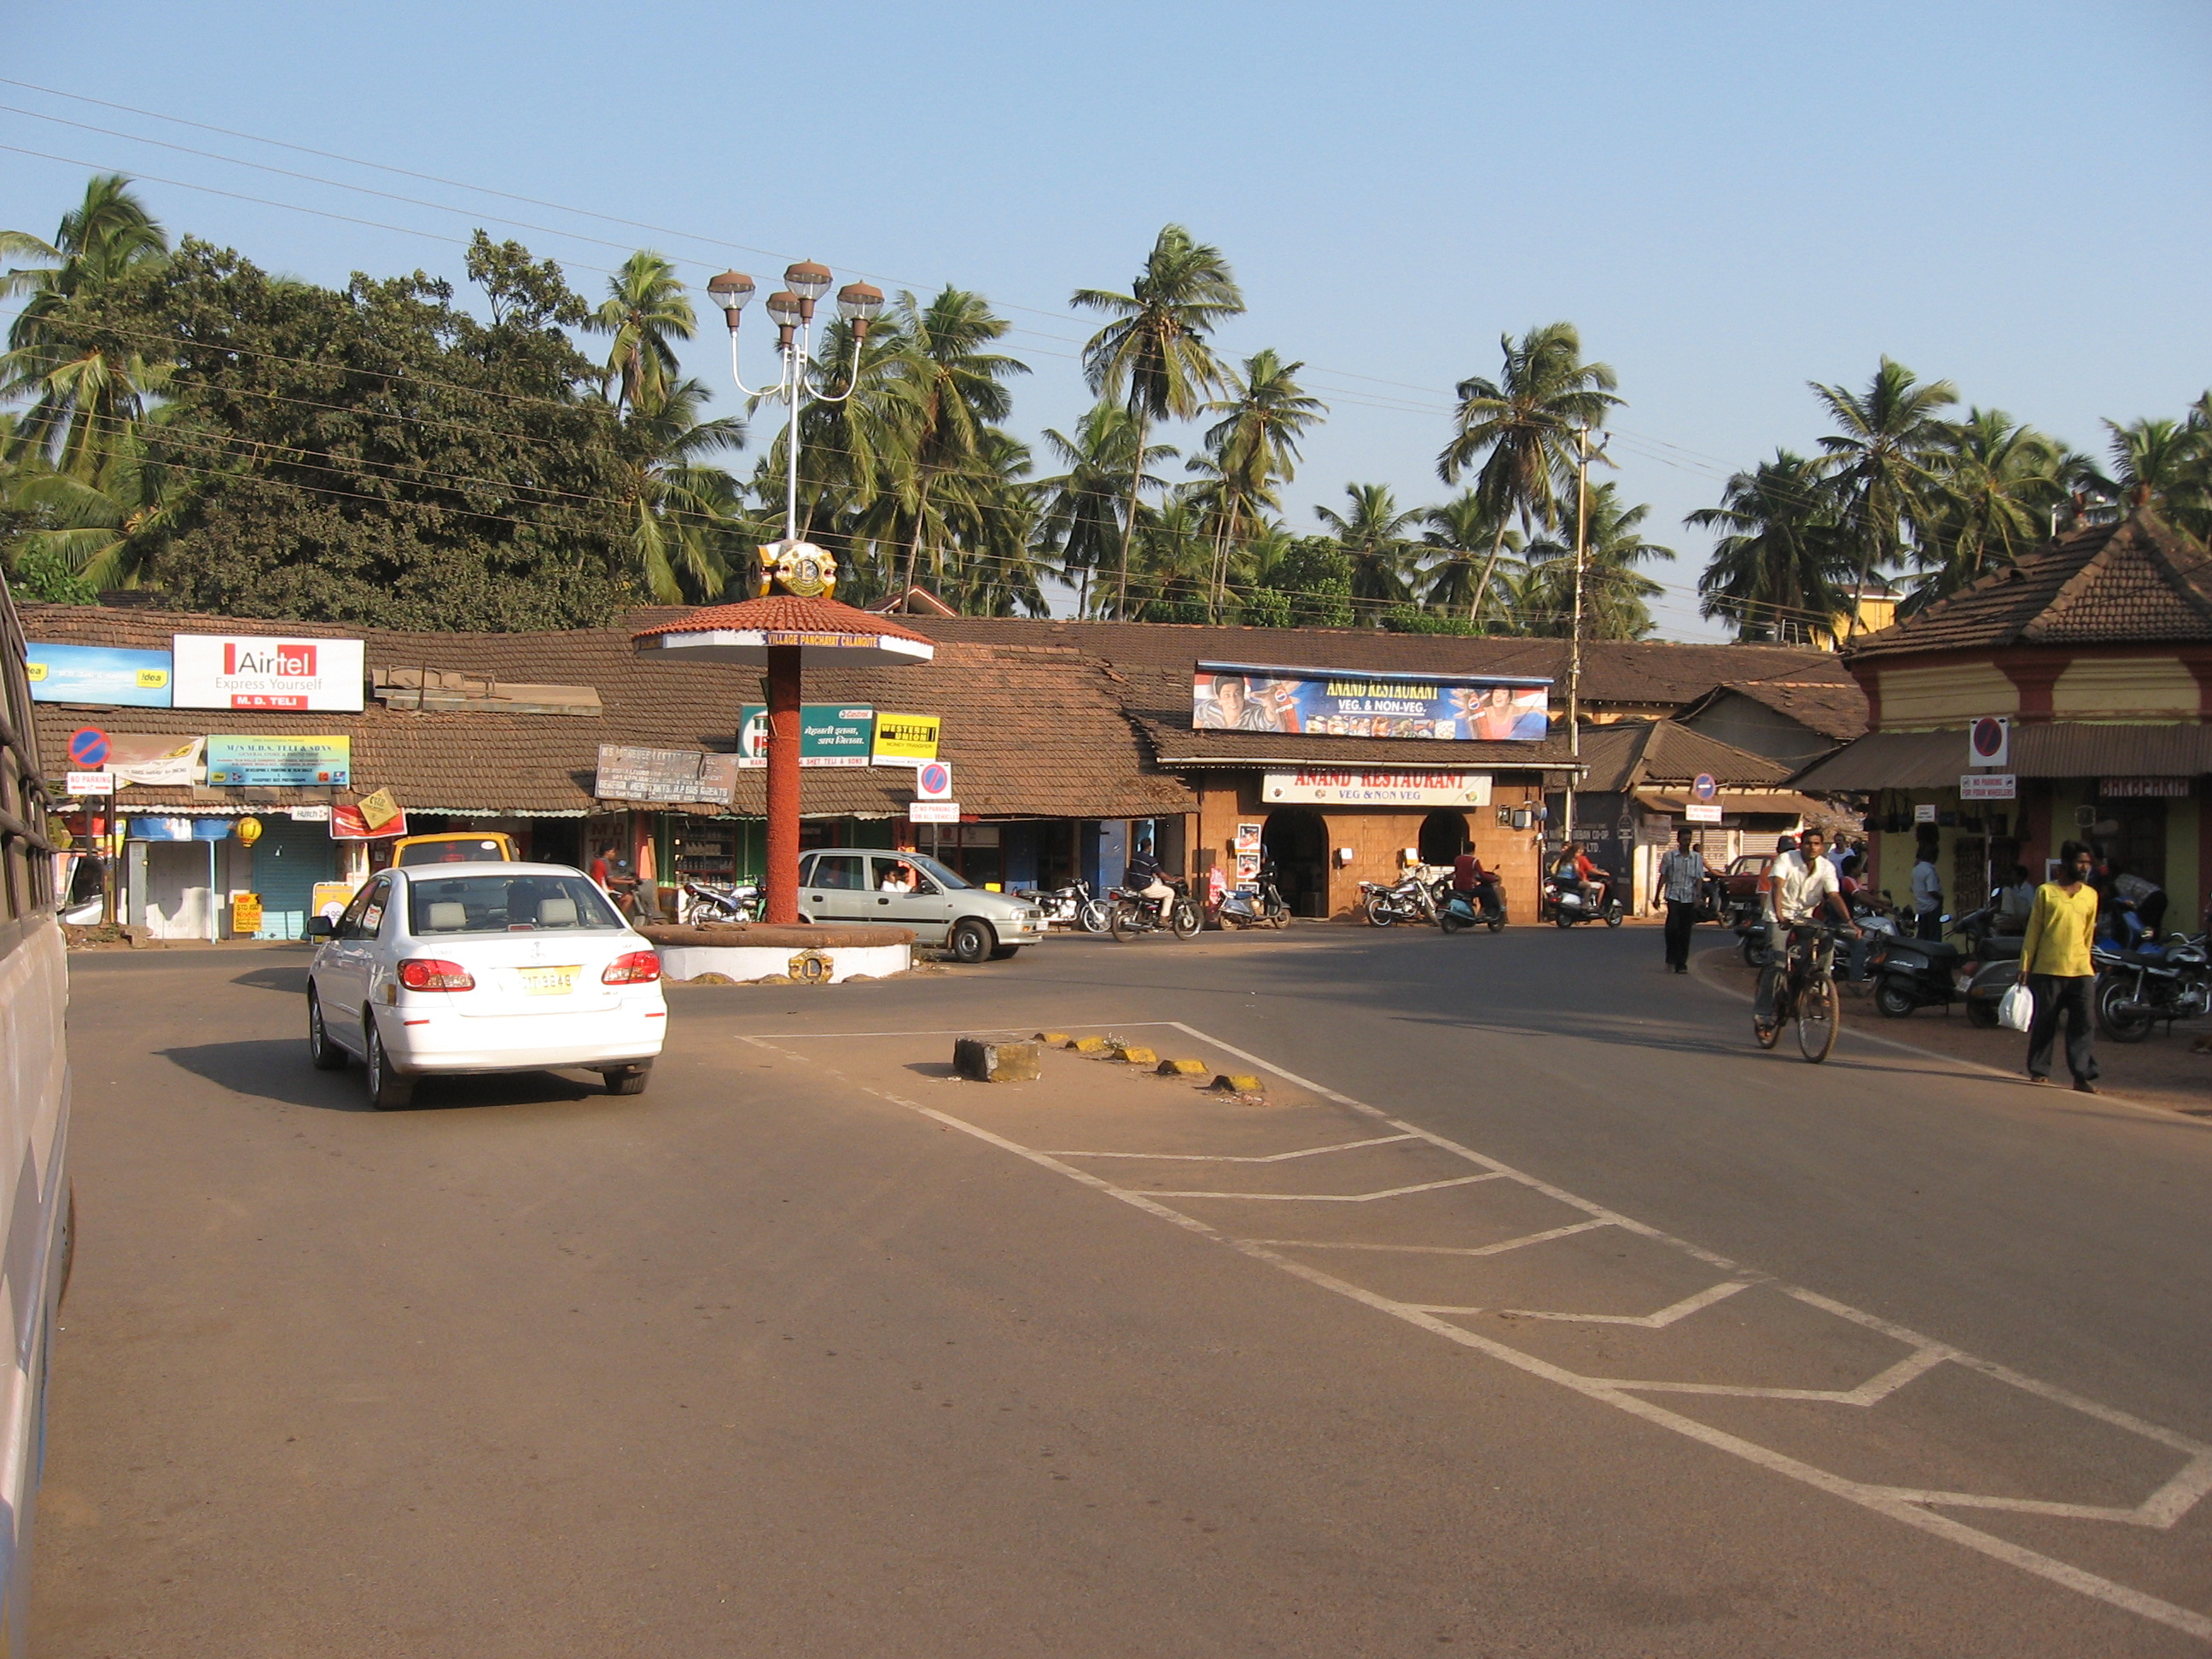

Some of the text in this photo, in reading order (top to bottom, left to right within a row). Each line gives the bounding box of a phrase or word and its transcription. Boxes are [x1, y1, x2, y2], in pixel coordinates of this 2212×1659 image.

[768, 633, 878, 648] VILLAGE PANCHAYAT CALANGUTE
[238, 651, 309, 674] Airtel
[215, 677, 323, 691] Express Yourself
[1326, 680, 1438, 700] ANAND RESTAURANT
[237, 696, 297, 706] M. D. TELI
[1338, 699, 1426, 713] VEG. & NON-VEG.
[882, 725, 928, 734] WESTERN
[895, 732, 927, 741] UNION
[83, 775, 111, 783] PARKING
[1295, 770, 1466, 789] ANAND RESTAURANT
[1339, 789, 1359, 799] VEG
[1400, 791, 1420, 800] VEG
